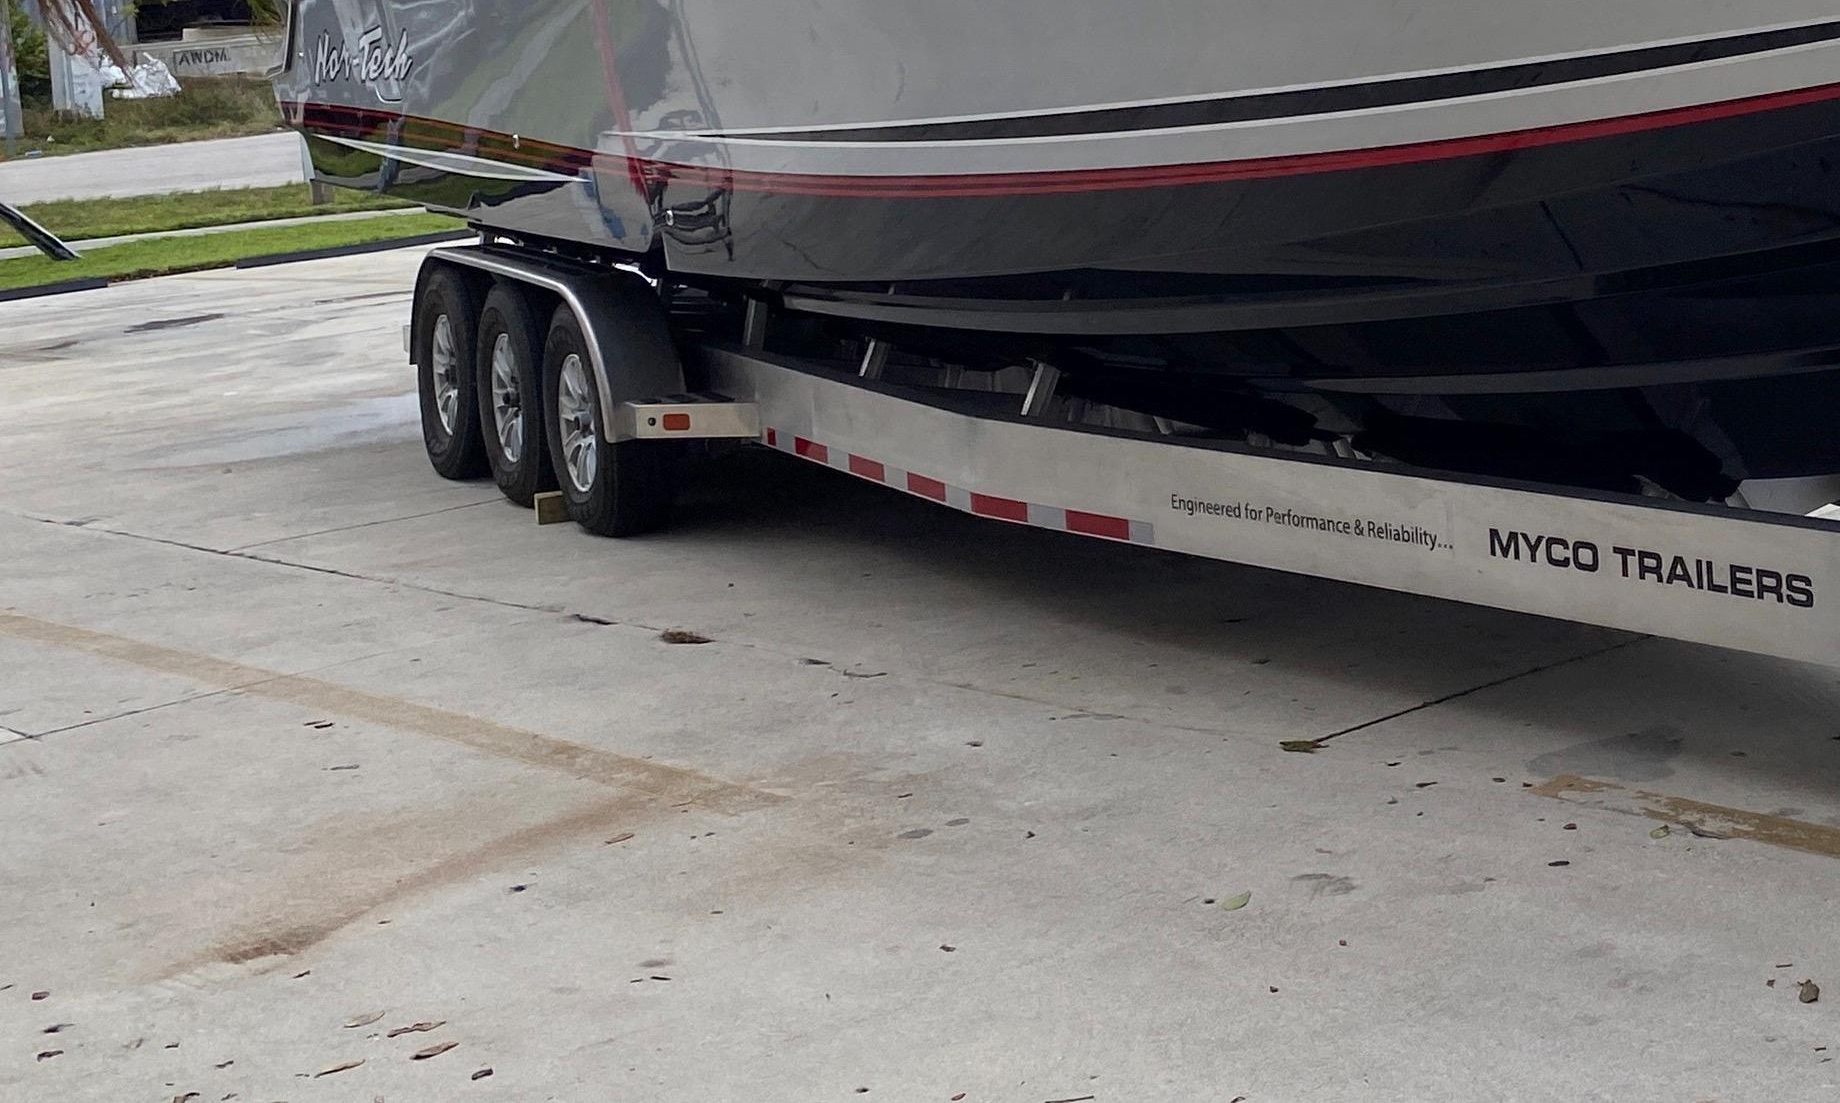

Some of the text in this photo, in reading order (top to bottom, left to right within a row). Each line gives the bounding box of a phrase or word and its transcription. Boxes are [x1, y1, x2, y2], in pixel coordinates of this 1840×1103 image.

[314, 24, 413, 87] Nor-Tech
[1171, 494, 1242, 519] Engineered
[1245, 503, 1263, 522] for
[1265, 506, 1351, 535] Performance
[1354, 519, 1365, 536] &
[1489, 528, 1815, 608] MYCO TRAILERS
